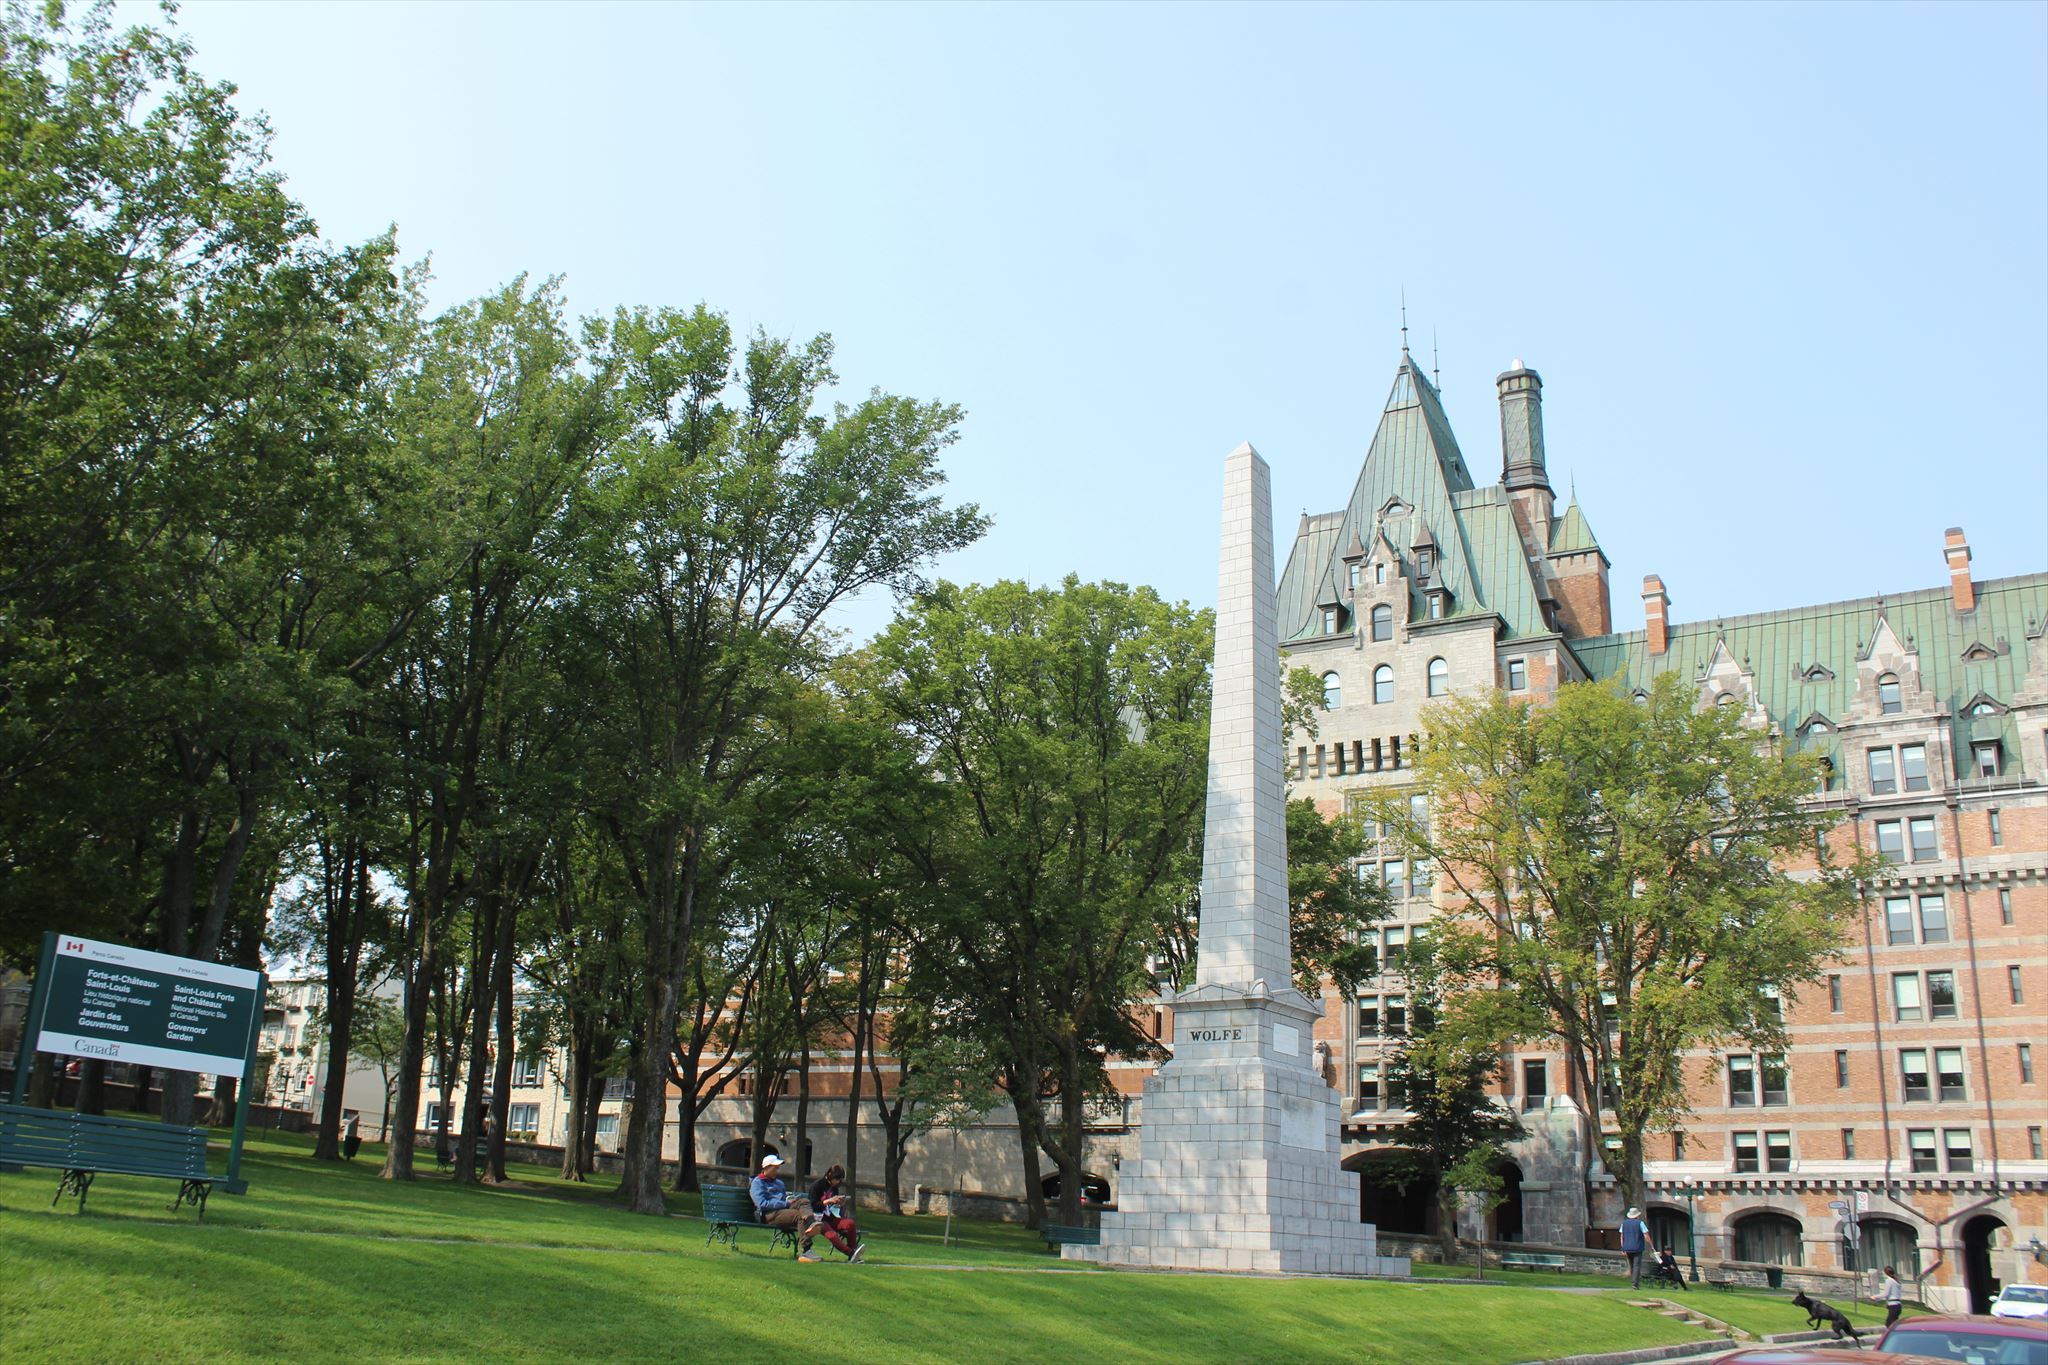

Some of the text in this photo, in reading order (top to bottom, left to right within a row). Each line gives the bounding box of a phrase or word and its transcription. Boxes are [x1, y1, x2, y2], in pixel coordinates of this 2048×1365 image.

[87, 969, 160, 988] Forts-et-Châteaux-
[86, 979, 130, 993] Saint-Louis
[98, 992, 127, 1002] historique
[174, 985, 235, 1002] Saint-Louis Forts
[92, 999, 116, 1008] Canada
[189, 997, 222, 1008] Châteaux
[80, 1008, 122, 1021] Jardin des
[176, 1013, 198, 1021] Canada
[195, 1009, 215, 1017] Historic
[79, 1018, 129, 1032] Gouverneurs
[166, 1031, 194, 1041] Garden
[1190, 1030, 1241, 1042] WOLFE
[75, 1039, 120, 1056] Canada
